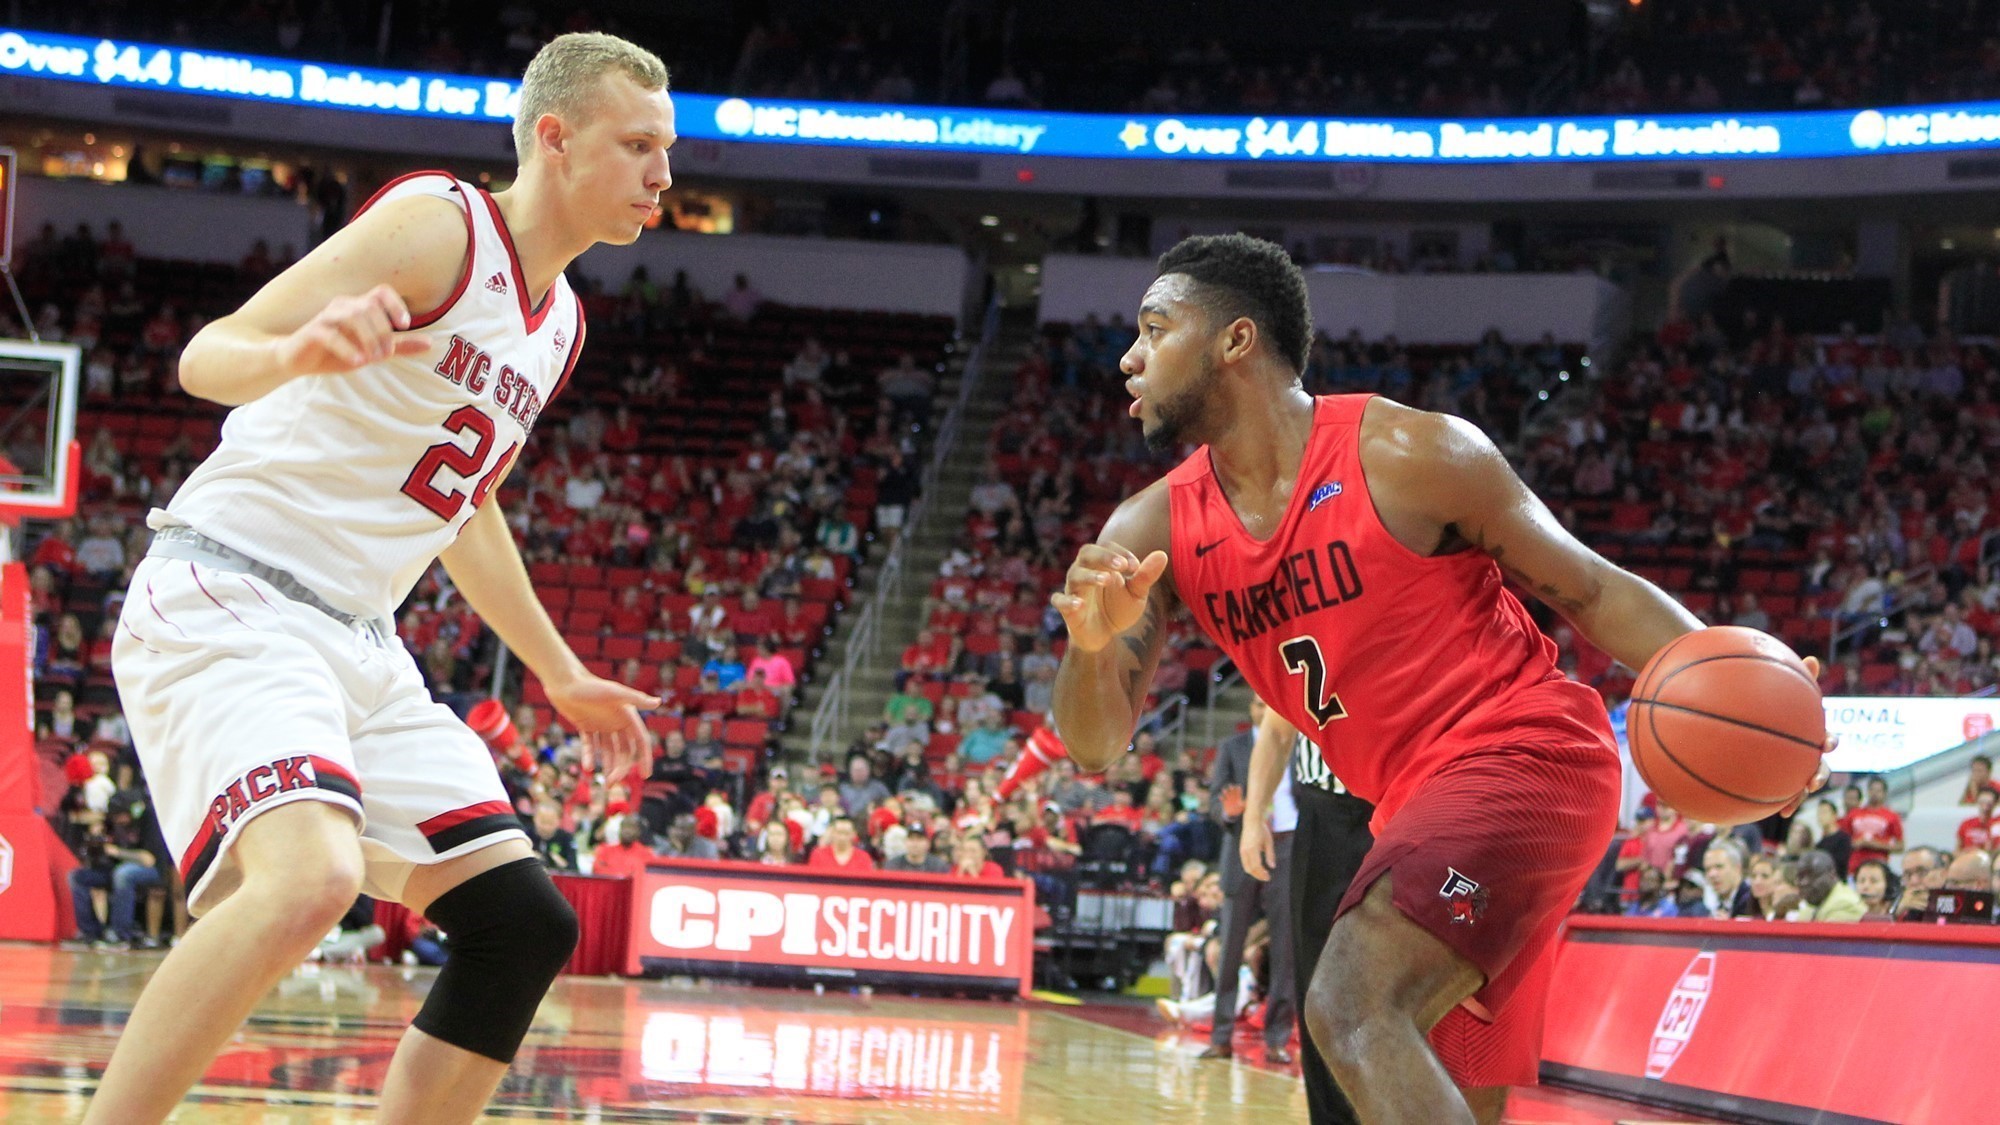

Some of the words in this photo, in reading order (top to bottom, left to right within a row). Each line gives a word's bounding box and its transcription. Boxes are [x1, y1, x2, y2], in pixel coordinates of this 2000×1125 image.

[0, 32, 88, 76] Over
[94, 39, 172, 84] $4.4
[426, 79, 480, 115] for
[939, 116, 1047, 152] Lottery
[1153, 119, 1240, 154] Over
[1245, 117, 1319, 158] $4.4
[1556, 121, 1609, 157] for
[1613, 118, 1780, 155] Education
[434, 334, 491, 396] NC
[1278, 634, 1349, 731] 2
[210, 755, 318, 837] PACK
[1439, 866, 1479, 897] F
[650, 885, 822, 956] CPI
[821, 895, 1015, 967] SECURITY
[1661, 993, 1702, 1035] CPI
